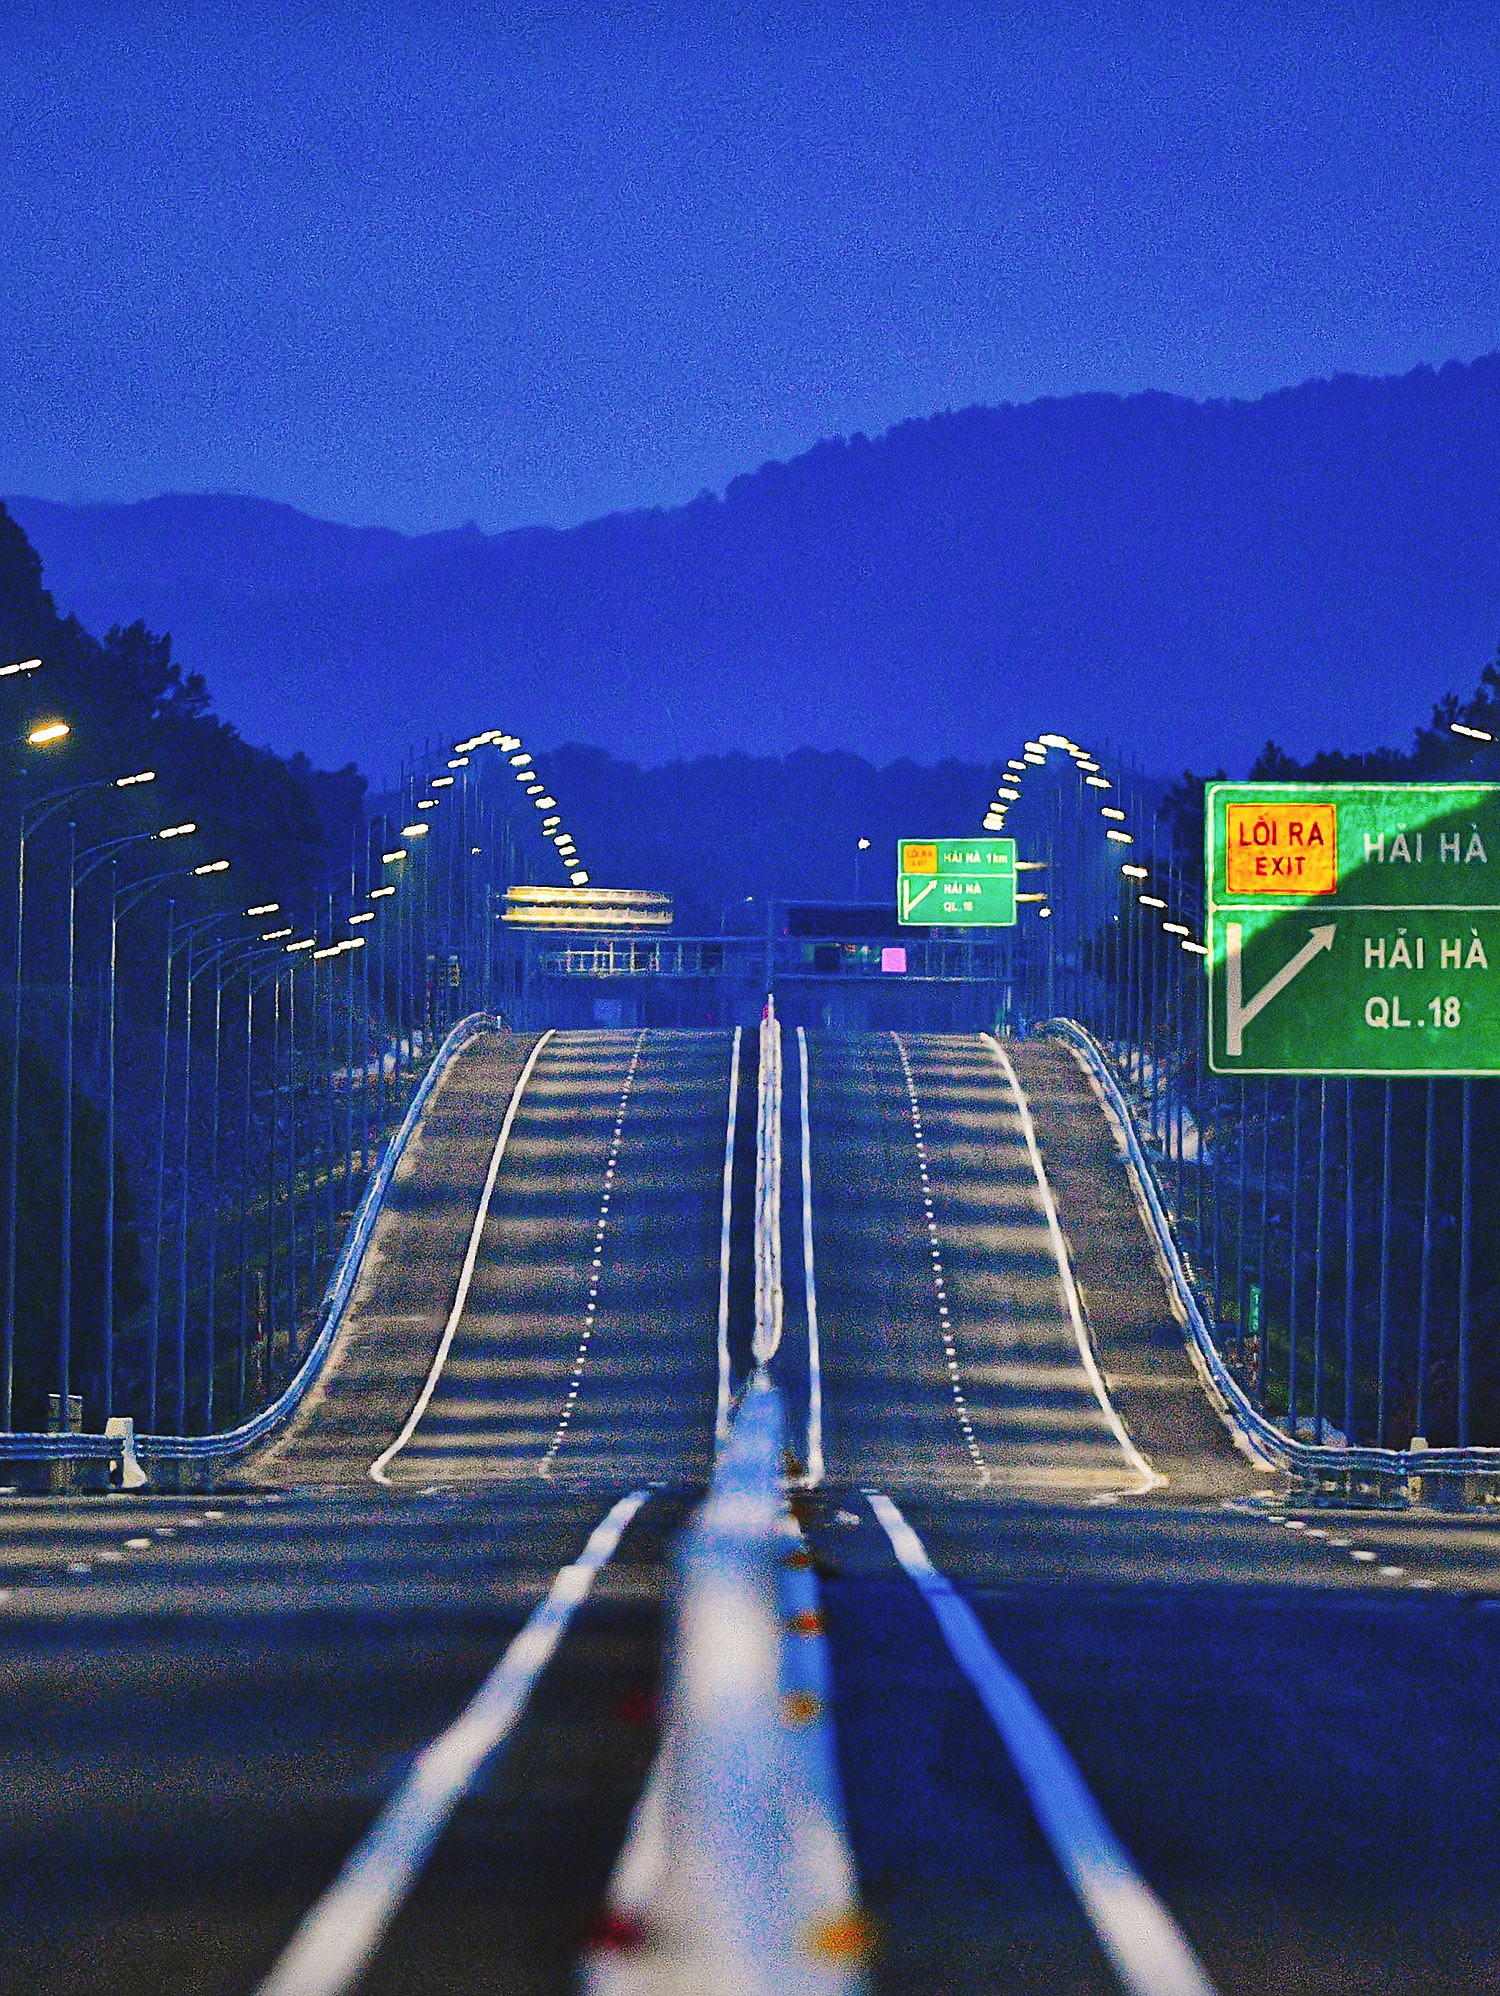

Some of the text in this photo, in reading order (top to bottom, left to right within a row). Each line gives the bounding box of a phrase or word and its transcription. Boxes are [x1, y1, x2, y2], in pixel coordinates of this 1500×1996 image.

[1289, 821, 1324, 846] RA
[1363, 823, 1487, 863] HẢI HÀ
[1256, 856, 1306, 876] EXIT
[1364, 927, 1488, 969] HẢI HÀ
[1365, 996, 1460, 1029] QL.18
